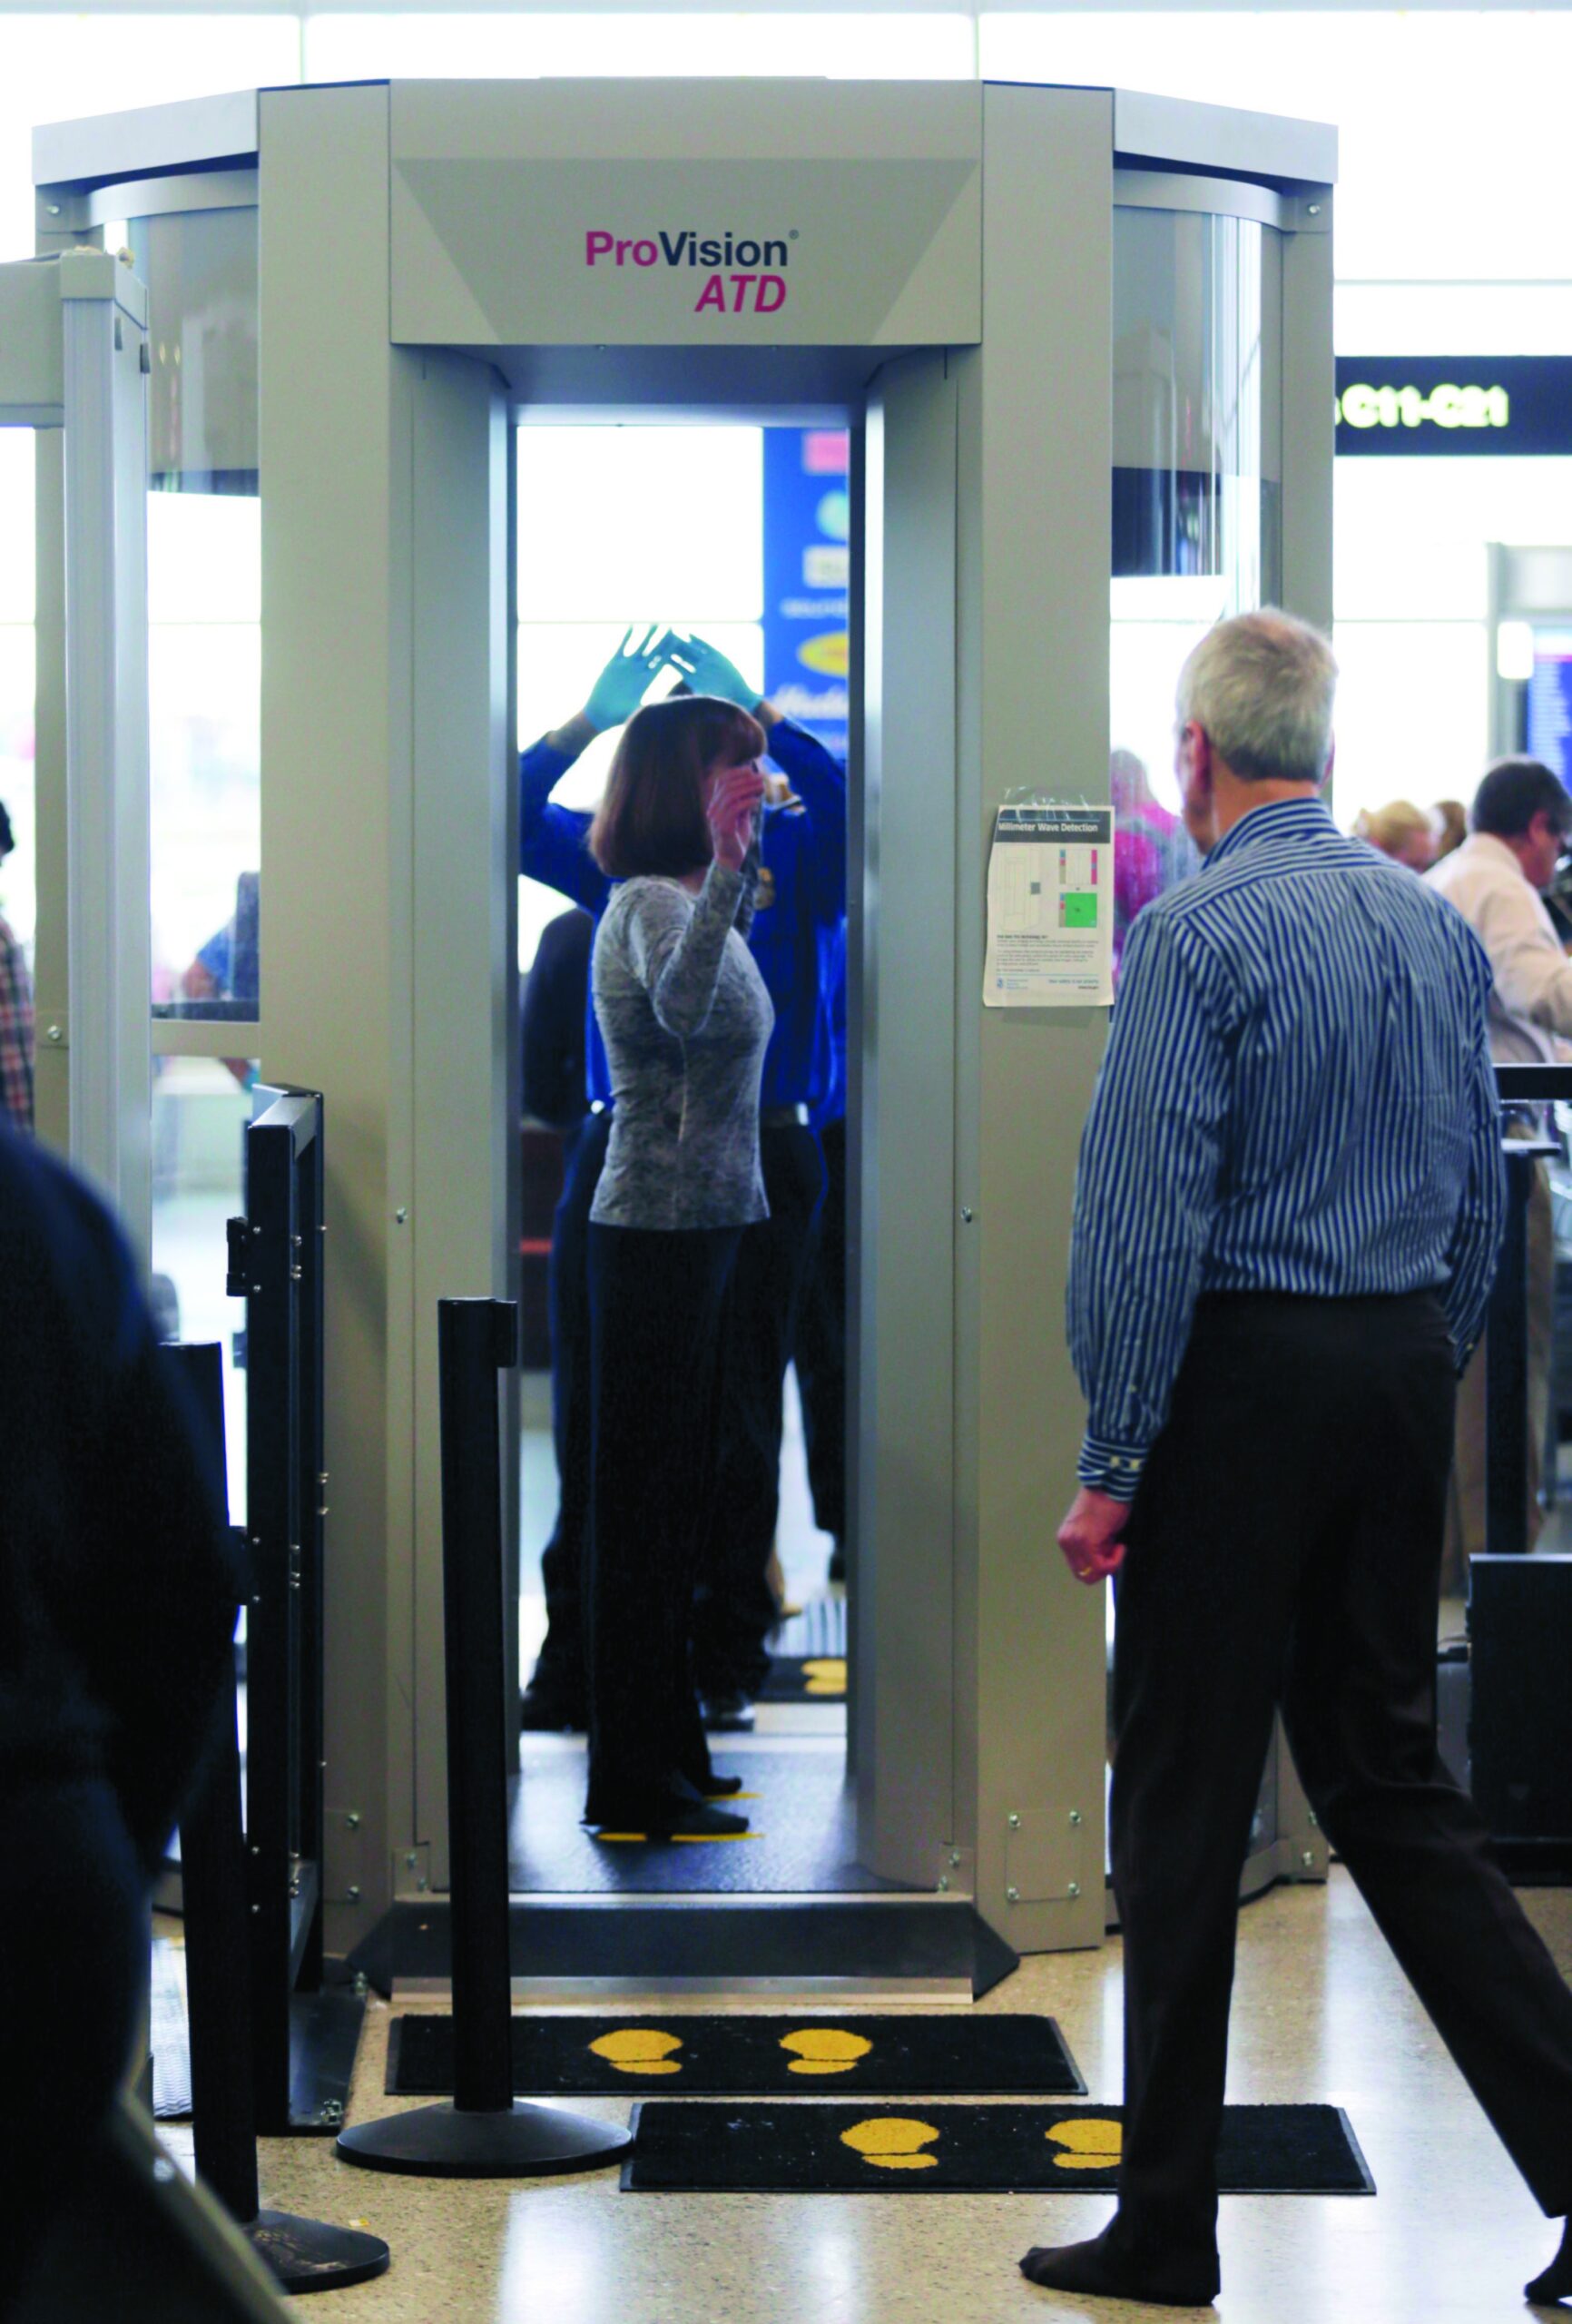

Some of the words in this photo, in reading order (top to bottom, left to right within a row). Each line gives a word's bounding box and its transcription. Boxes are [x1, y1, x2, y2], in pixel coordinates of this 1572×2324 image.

[693, 274, 787, 313] ATD
[998, 822, 1036, 832] Millimeter
[1037, 822, 1060, 832] Wave
[1061, 822, 1098, 832] Detection
